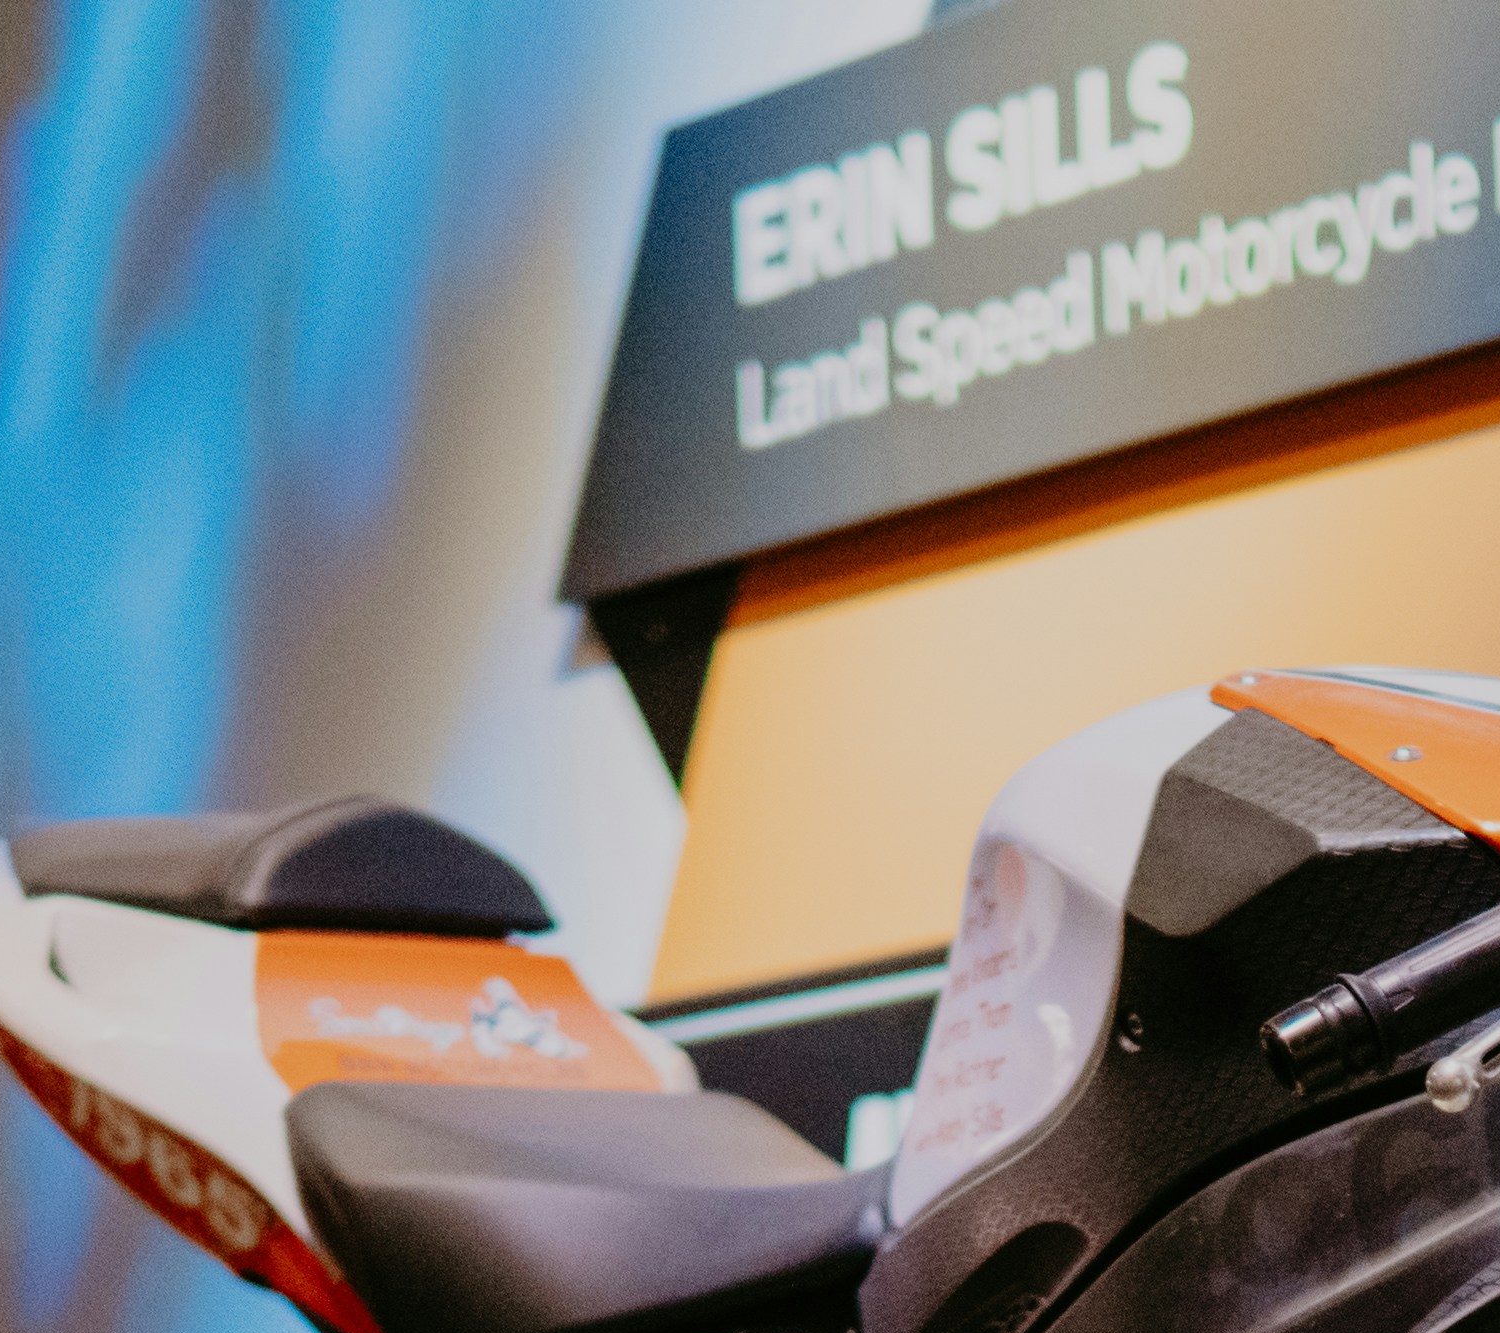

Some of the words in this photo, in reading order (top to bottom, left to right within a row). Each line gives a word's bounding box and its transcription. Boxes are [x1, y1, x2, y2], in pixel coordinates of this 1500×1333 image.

[733, 131, 934, 306] ERIN
[945, 40, 1194, 231] SILLS
[737, 316, 890, 450] Land
[894, 250, 1096, 407] Speed
[1101, 140, 1482, 336] Motorcycle
